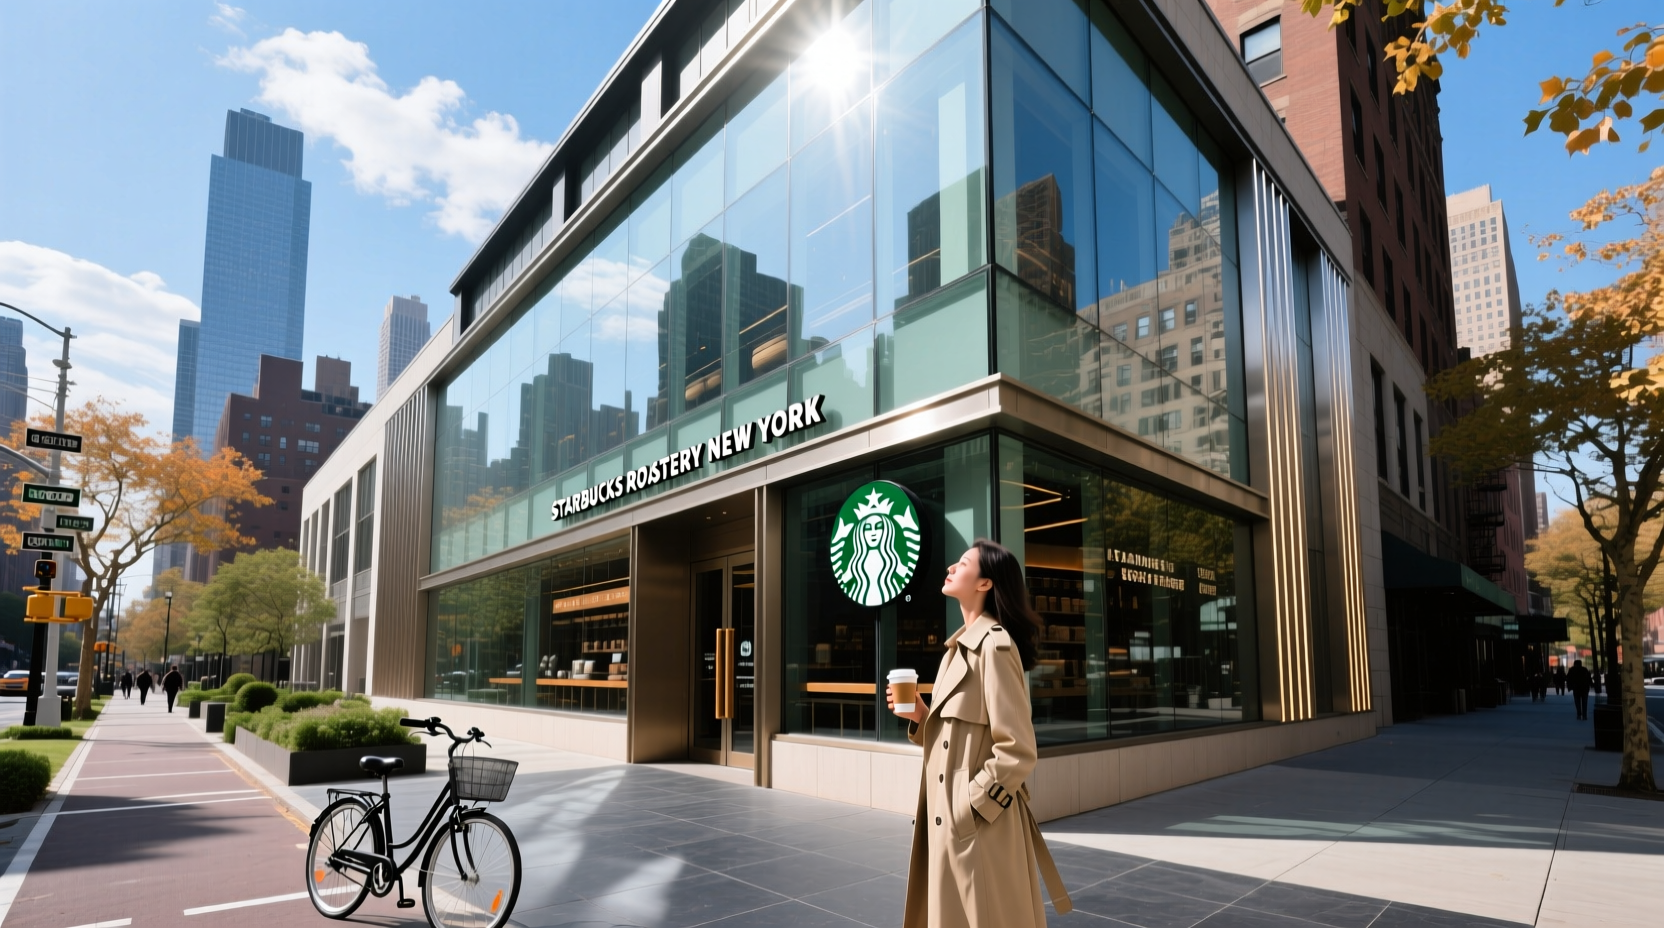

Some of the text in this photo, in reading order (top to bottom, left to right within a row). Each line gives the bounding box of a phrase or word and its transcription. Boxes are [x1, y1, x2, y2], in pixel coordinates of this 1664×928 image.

[551, 475, 624, 521] STARBUCKS
[707, 421, 754, 462] NEW
[757, 394, 822, 443] YORK
